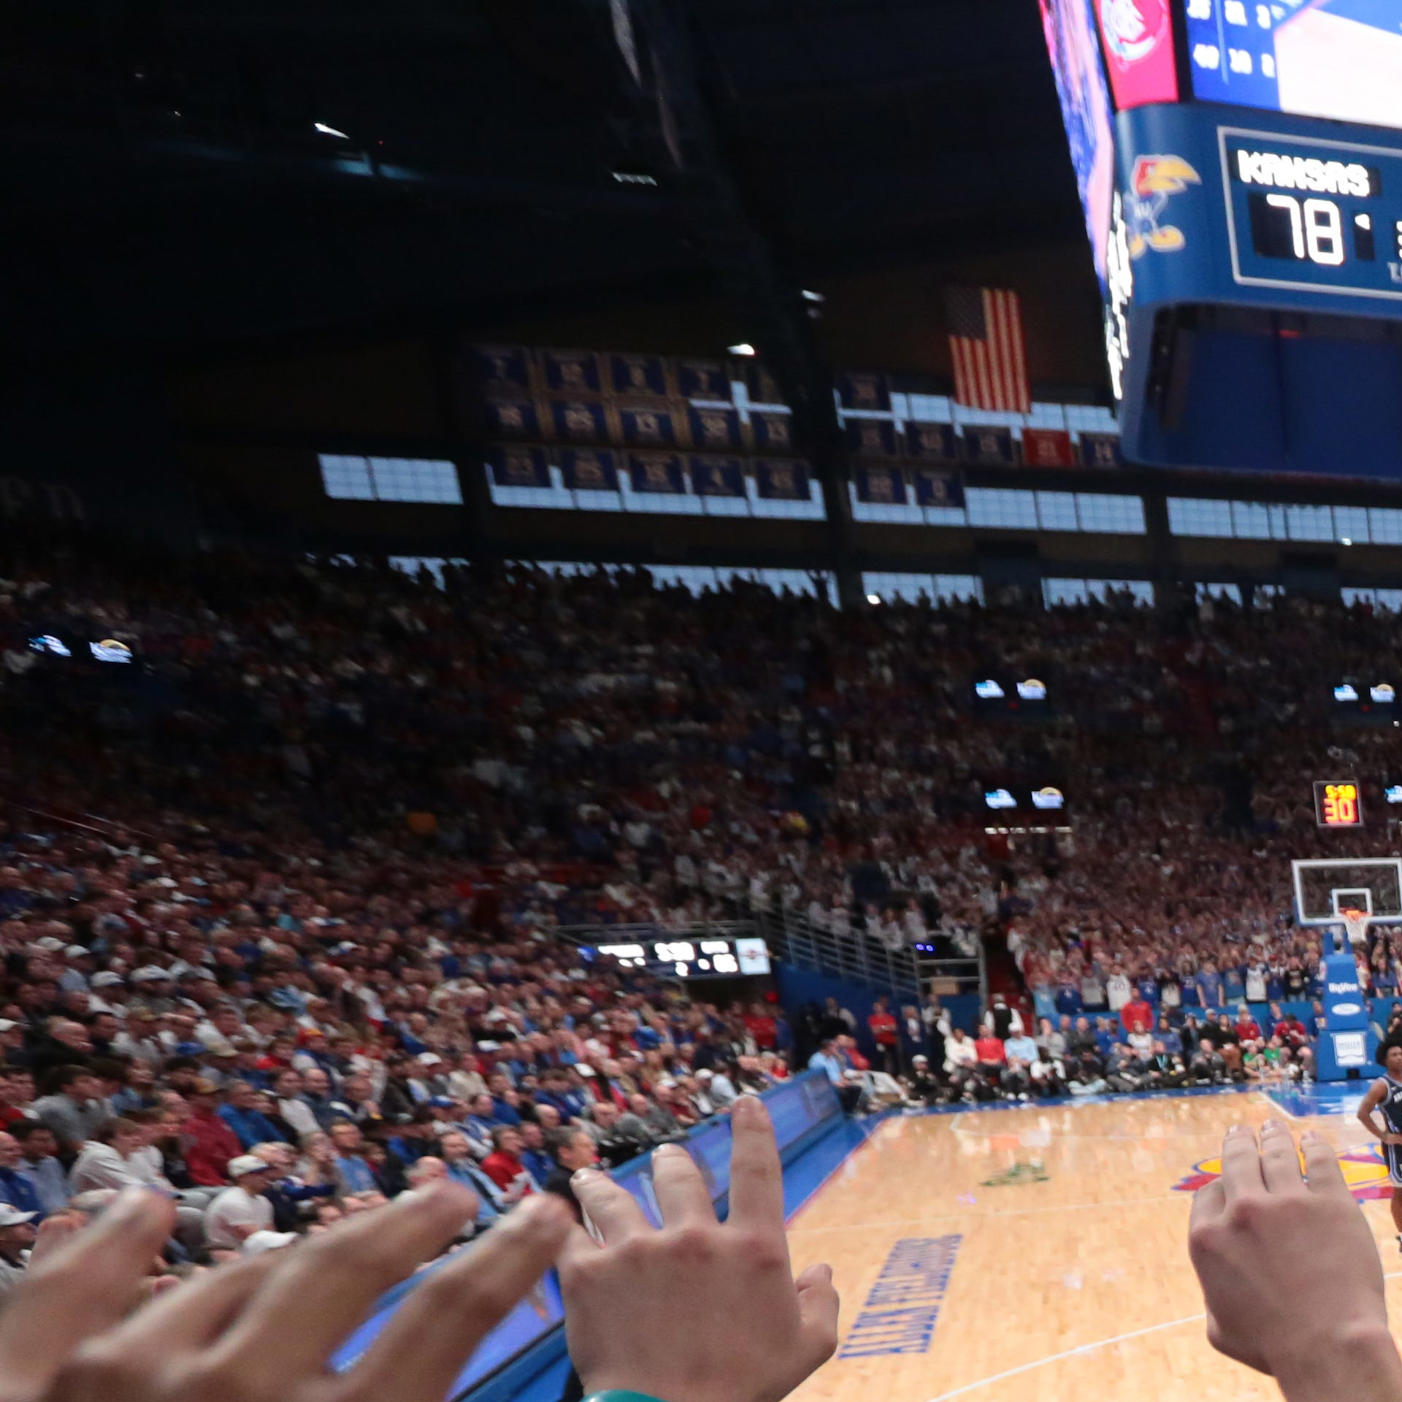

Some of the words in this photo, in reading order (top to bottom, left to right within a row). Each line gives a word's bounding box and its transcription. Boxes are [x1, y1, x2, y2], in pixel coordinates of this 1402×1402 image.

[1238, 149, 1370, 197] KANSAS
[1266, 194, 1344, 265] 78
[1324, 799, 1355, 823] 30
